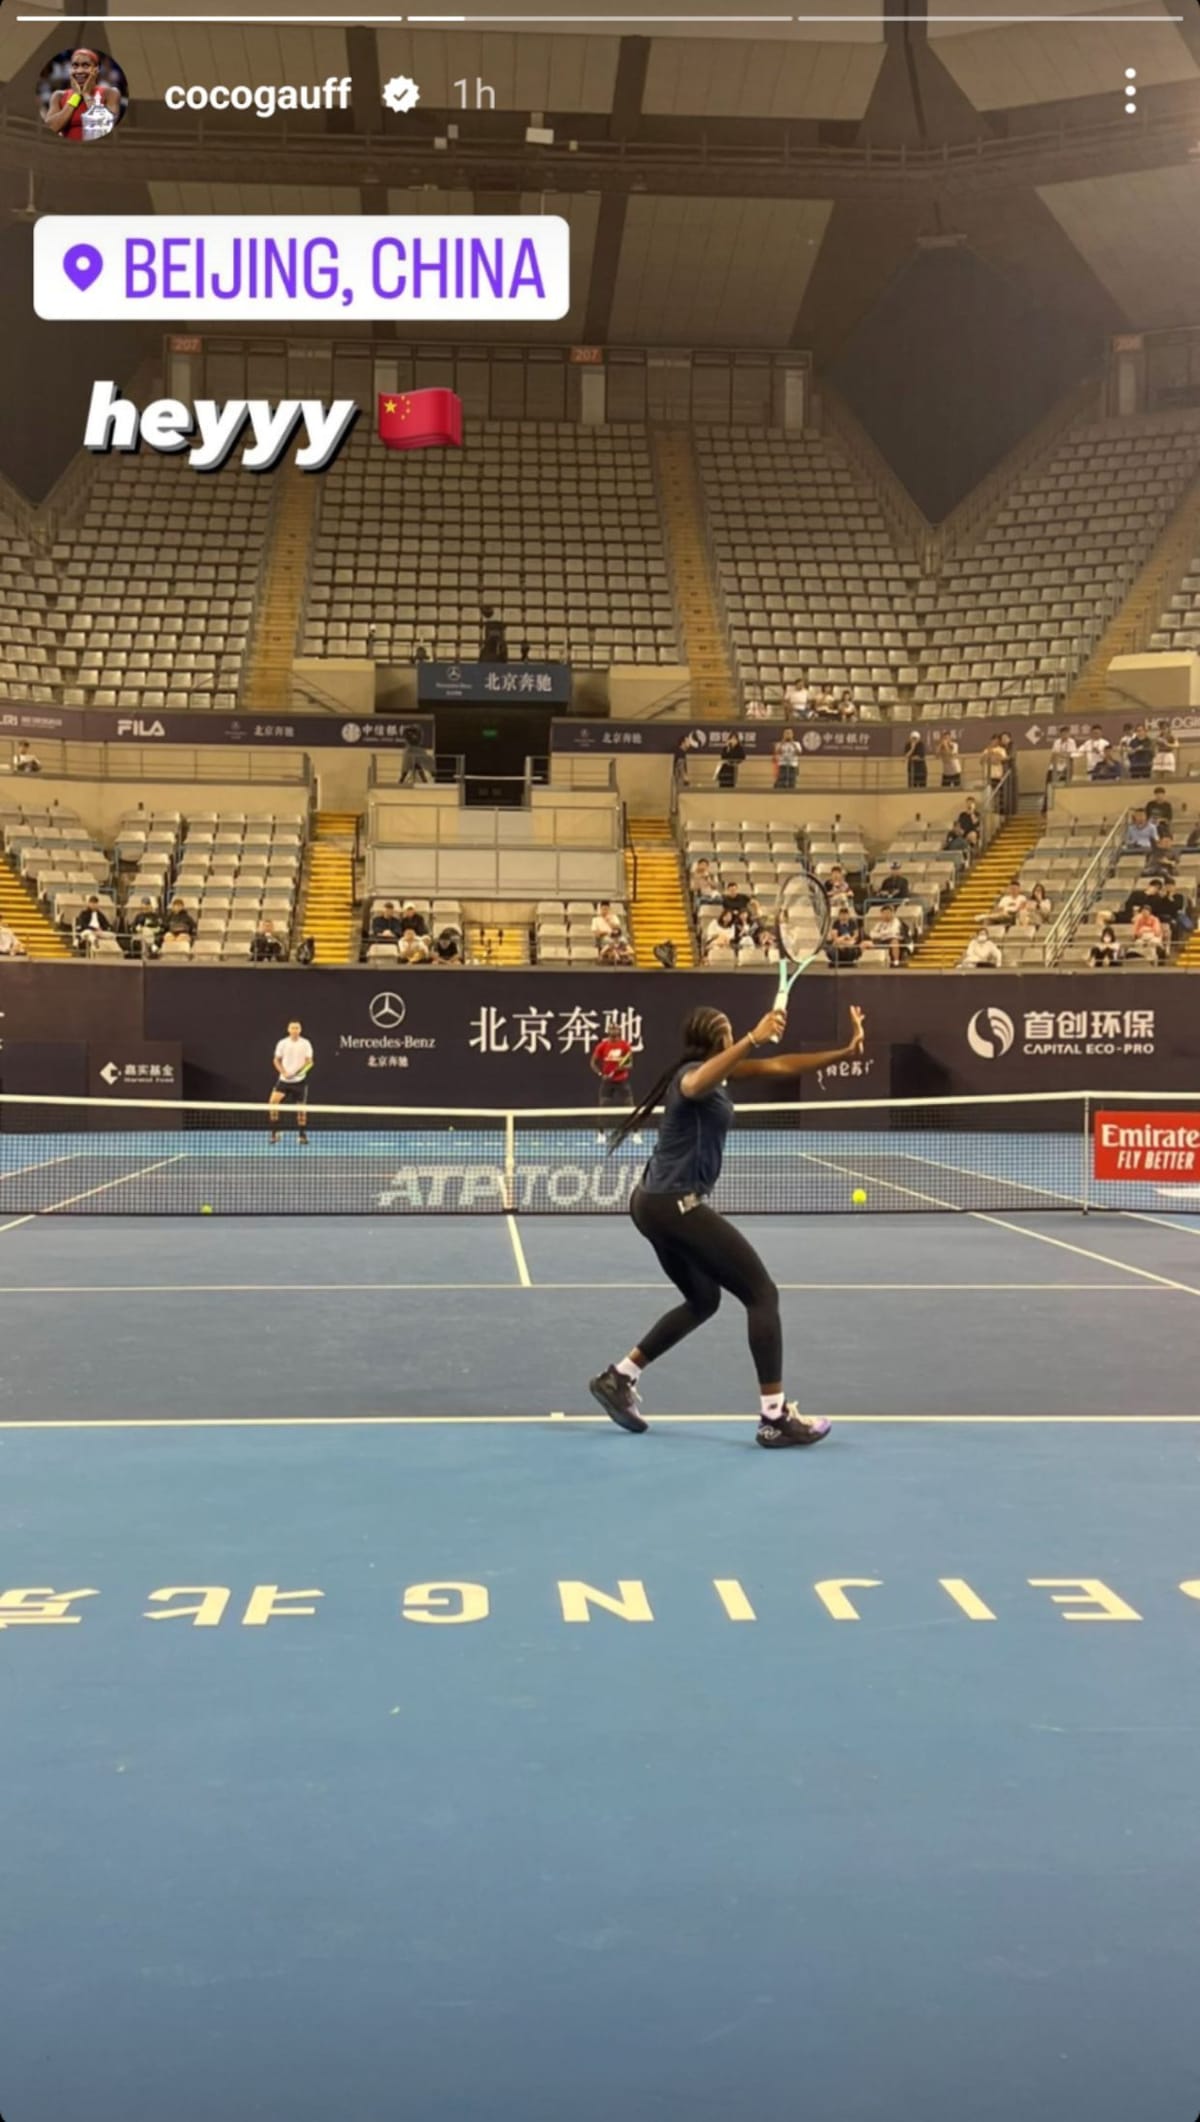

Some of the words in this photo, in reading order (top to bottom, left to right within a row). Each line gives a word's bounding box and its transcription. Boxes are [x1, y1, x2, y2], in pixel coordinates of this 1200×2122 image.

[484, 672, 552, 692] 北京奔驰
[117, 719, 165, 736] FILA
[468, 1006, 645, 1054] 北京奔驰
[1023, 1010, 1155, 1039] 首创环保
[340, 1034, 436, 1049] Mercedes-Benz
[1023, 1043, 1083, 1055] CAPITAL
[1085, 1043, 1155, 1055] ECO-PRO
[368, 1055, 409, 1068] 北京奔驰
[1117, 1150, 1141, 1169] FLY
[1144, 1150, 1195, 1170] BETTER
[373, 1164, 508, 1206] ATP
[402, 1578, 1200, 1625] EIJING
